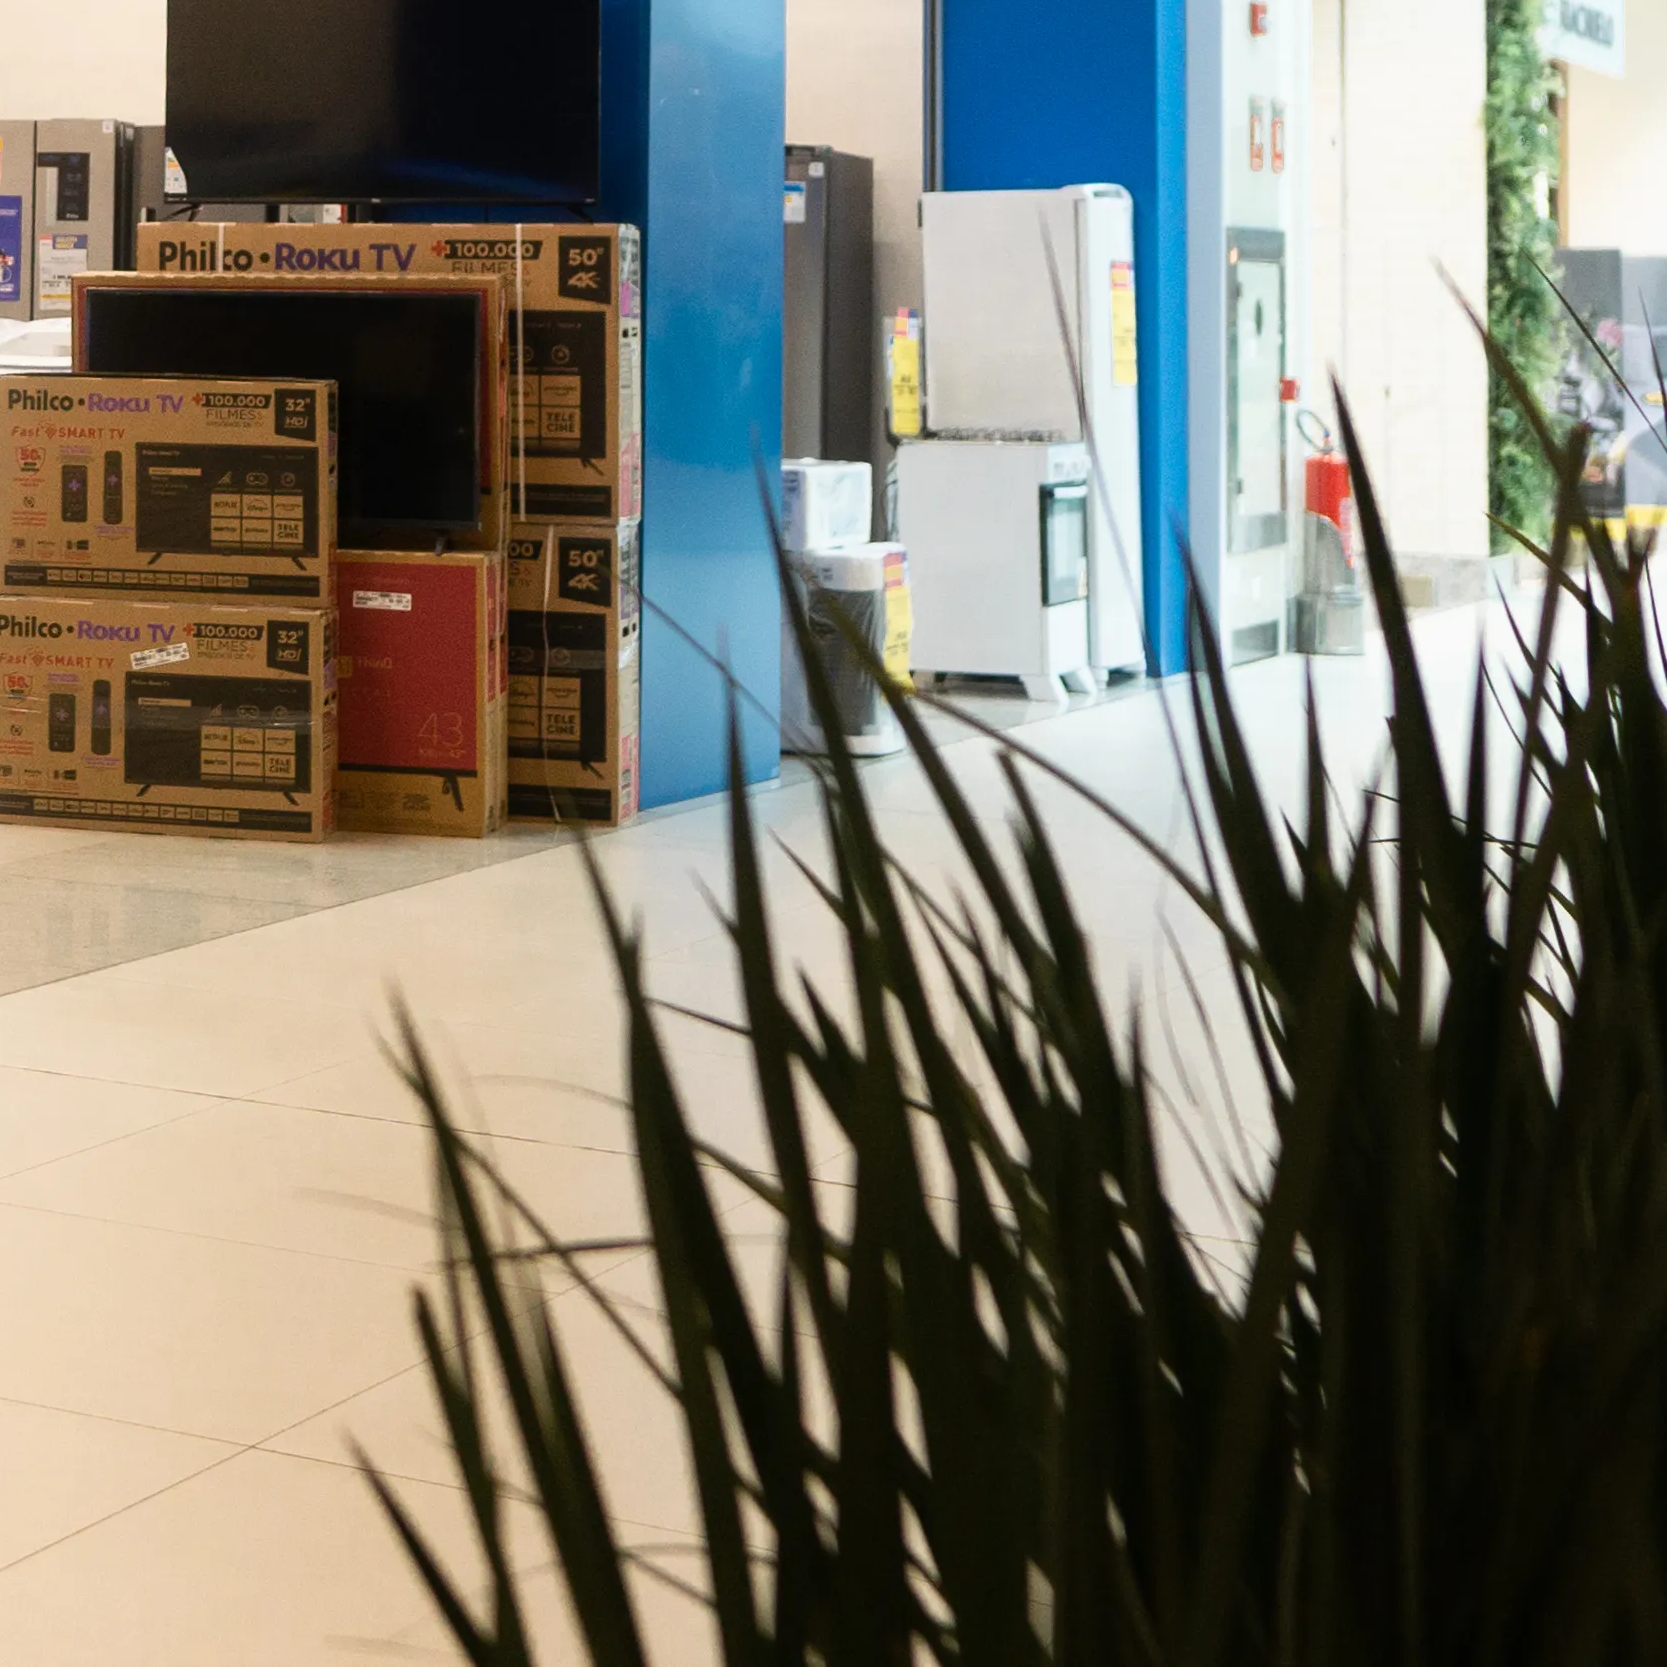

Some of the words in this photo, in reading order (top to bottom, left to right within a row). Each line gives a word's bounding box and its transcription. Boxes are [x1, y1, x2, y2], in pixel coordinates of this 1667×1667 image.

[158, 240, 253, 273] Philco
[274, 243, 360, 271] Roku
[369, 243, 417, 272] TV
[7, 388, 74, 411] Philco
[87, 392, 151, 412] Roku
[156, 394, 184, 413] TV
[206, 408, 257, 421] FILMES
[546, 408, 576, 422] TELE
[58, 427, 103, 439] SMART
[109, 427, 126, 440] TV
[546, 421, 576, 433] CINE
[277, 522, 300, 532] TELE
[276, 531, 300, 540] CINE
[76, 620, 141, 642] Roku
[147, 623, 177, 644] TV
[196, 639, 248, 652] FILMES
[45, 655, 92, 668] SMART
[97, 656, 114, 669] TV
[546, 712, 576, 724] TELE
[417, 711, 464, 749] 43
[546, 723, 576, 735] CINE
